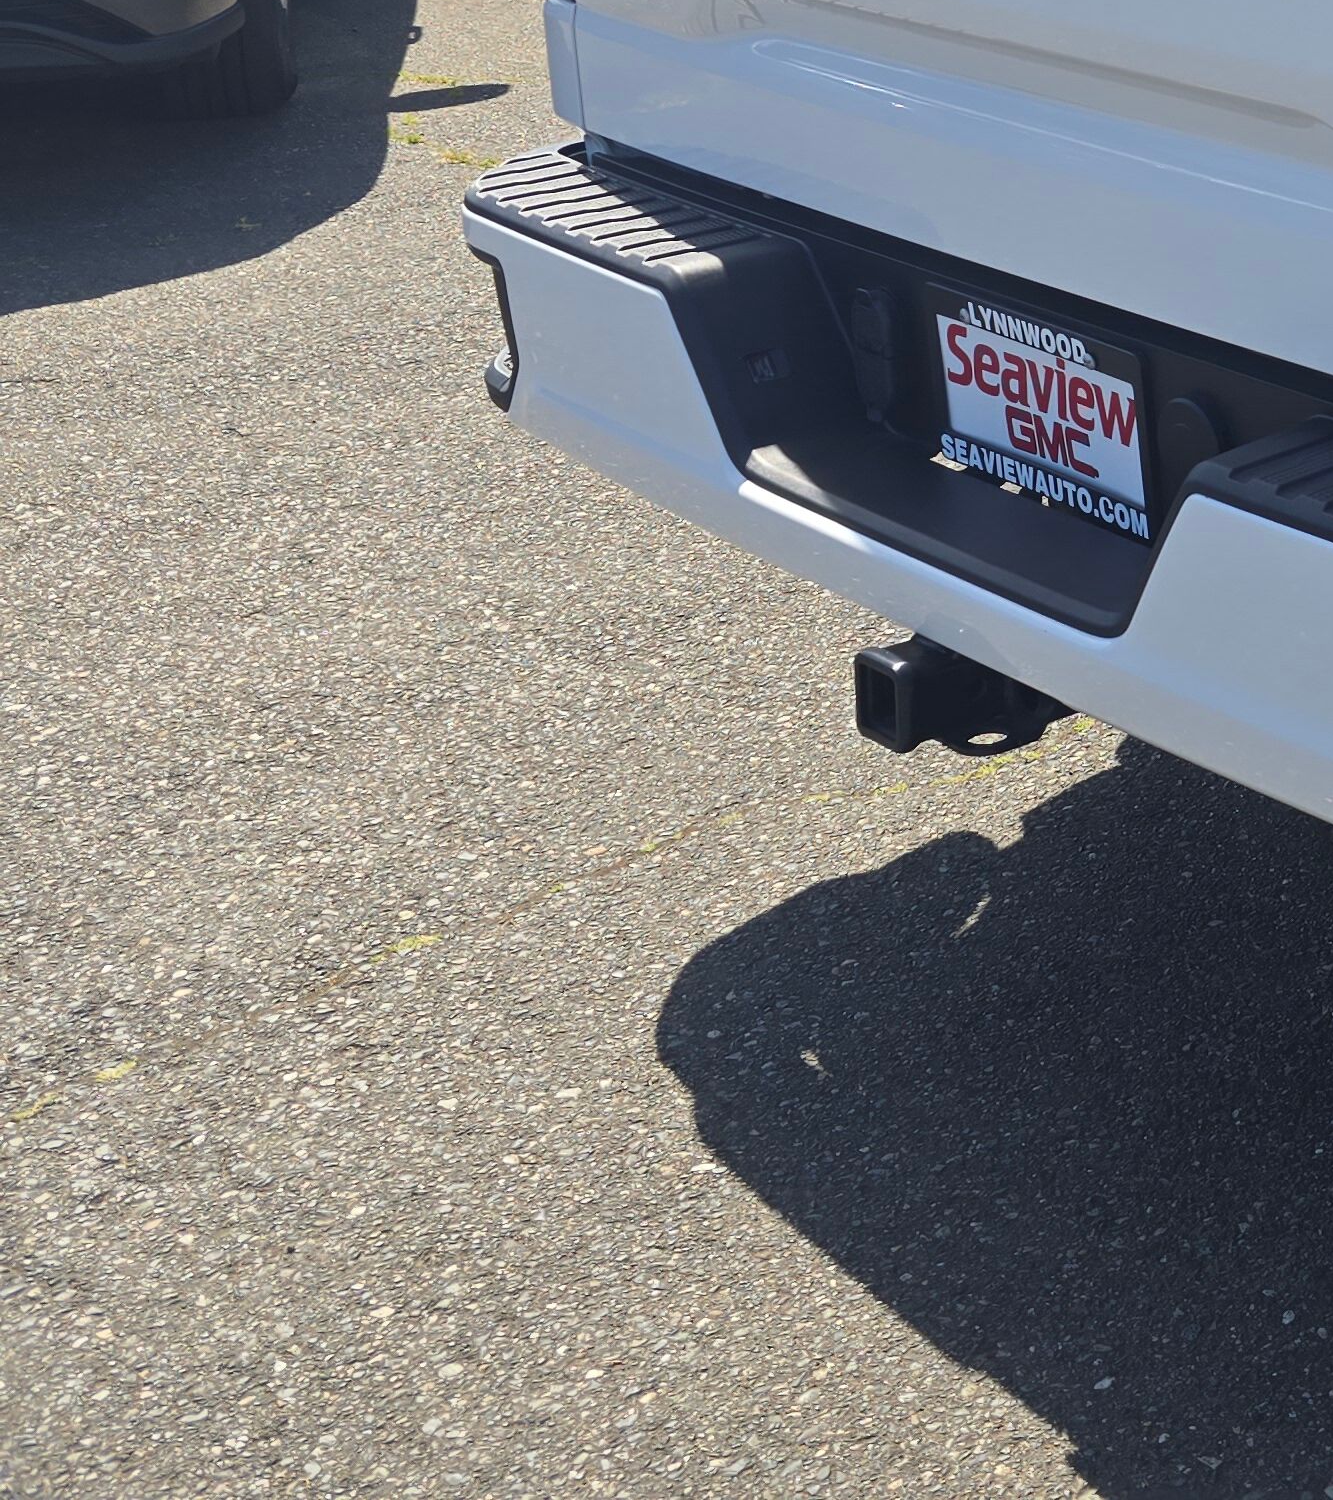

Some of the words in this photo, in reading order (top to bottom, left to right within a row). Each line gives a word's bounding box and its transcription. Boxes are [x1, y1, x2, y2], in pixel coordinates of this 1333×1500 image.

[966, 301, 1087, 365] LYNNWOOD
[946, 323, 1137, 448] Seaview
[940, 433, 1150, 540] SEAVIEWAUTO.COM
[1004, 404, 1100, 480] GMC
